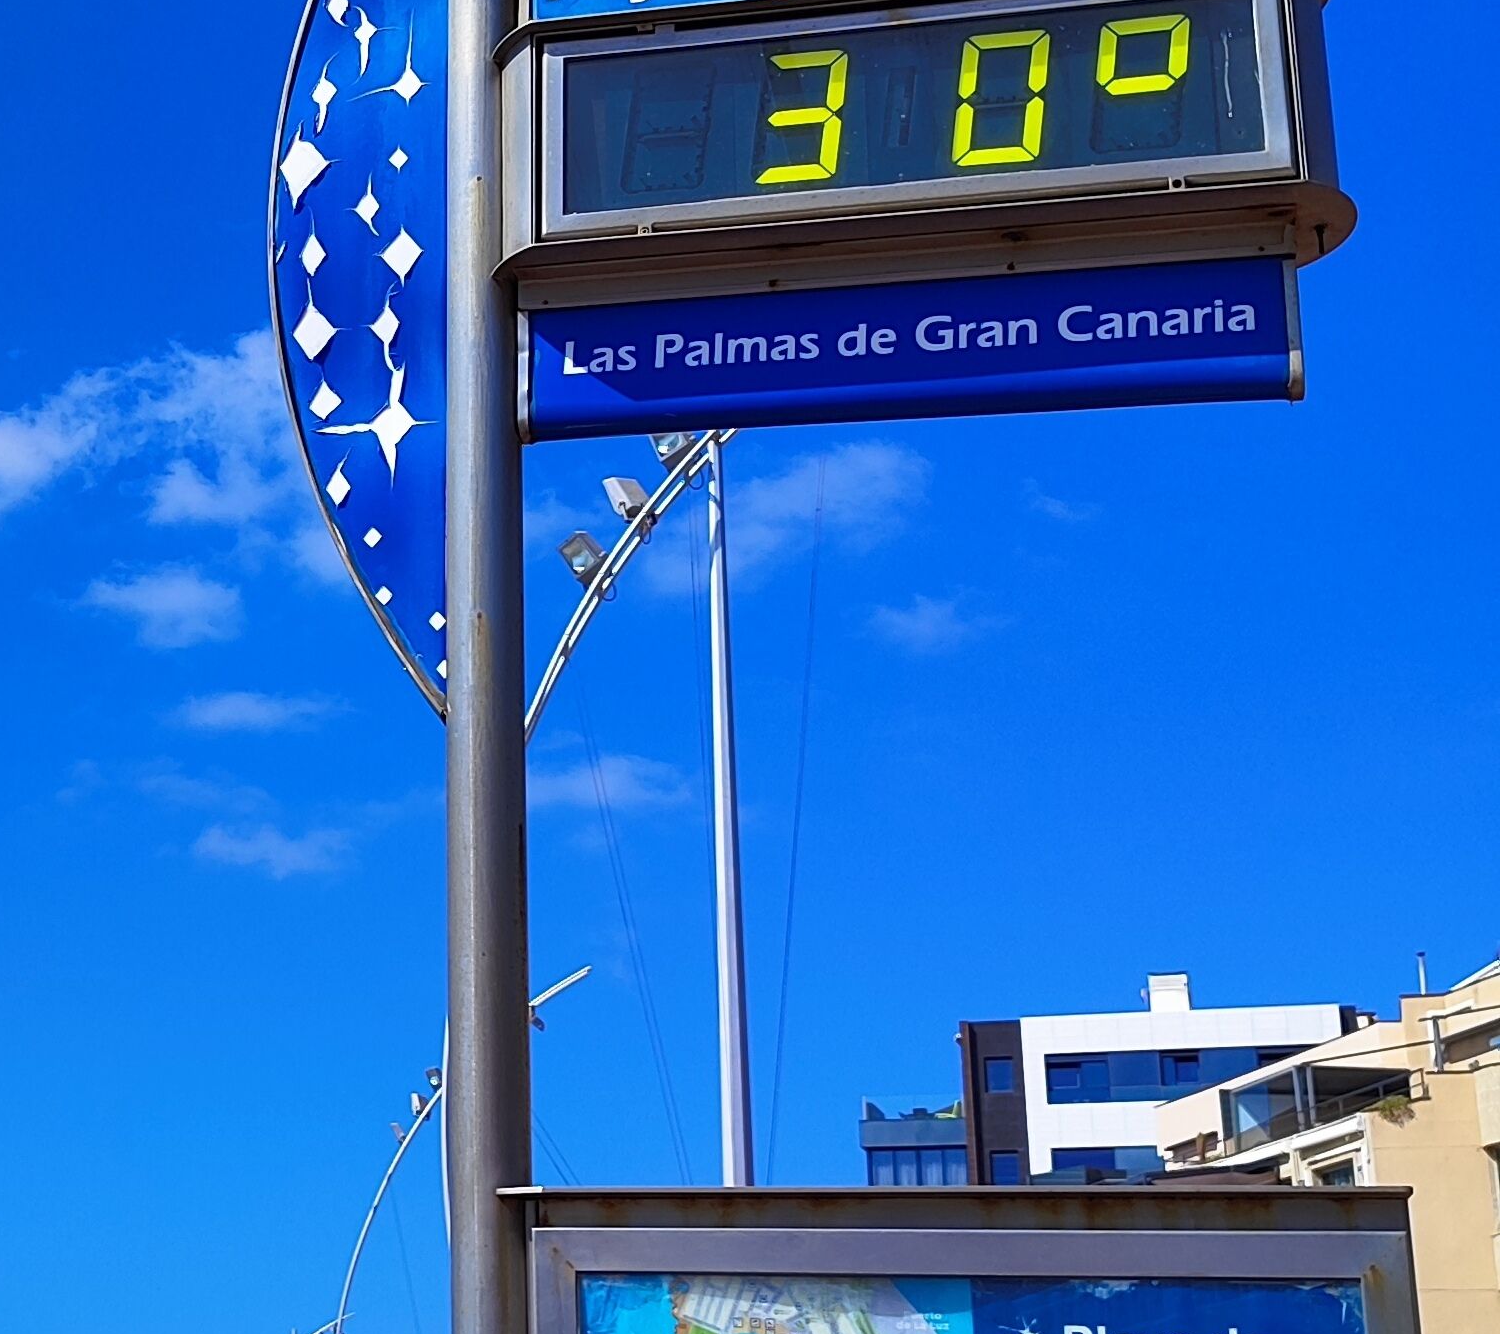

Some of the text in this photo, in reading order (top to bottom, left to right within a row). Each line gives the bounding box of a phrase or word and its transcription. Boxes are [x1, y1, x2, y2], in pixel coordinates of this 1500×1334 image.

[562, 299, 1256, 375] Las Palmas de Gran Canaria
